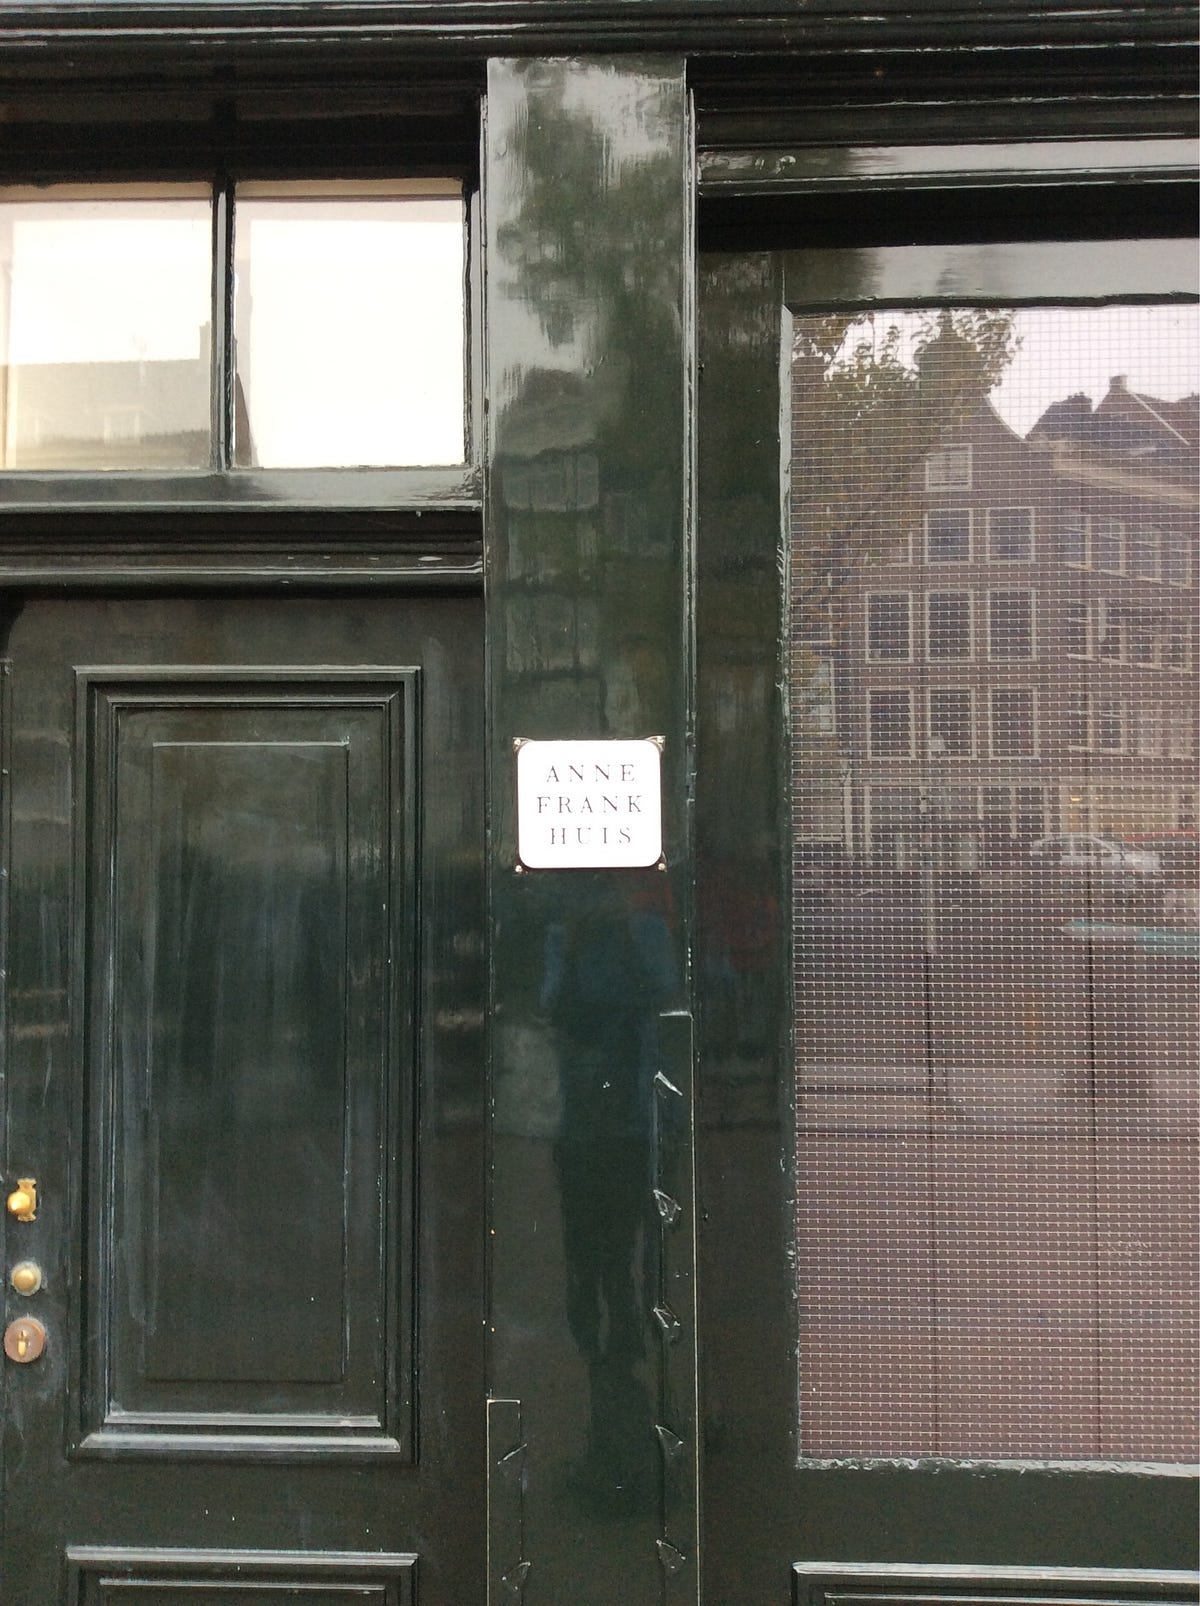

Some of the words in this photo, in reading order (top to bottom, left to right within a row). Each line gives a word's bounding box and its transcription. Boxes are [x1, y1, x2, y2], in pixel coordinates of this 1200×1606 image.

[546, 763, 635, 782] ANNE
[536, 794, 642, 814] FRANK
[550, 826, 632, 845] HUIS
